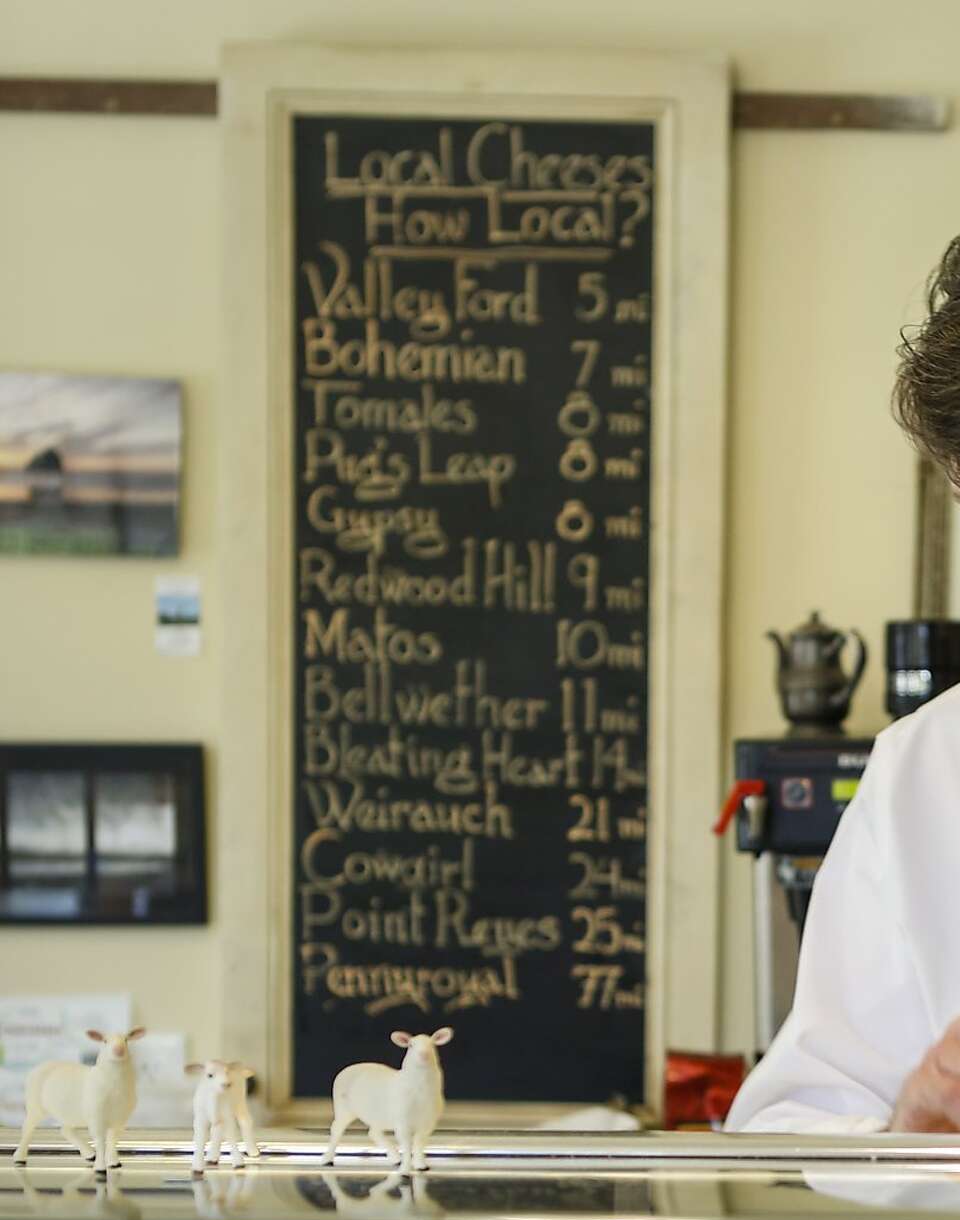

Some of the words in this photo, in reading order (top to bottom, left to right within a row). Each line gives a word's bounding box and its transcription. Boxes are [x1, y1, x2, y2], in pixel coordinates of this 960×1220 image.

[325, 127, 452, 194] Local
[365, 190, 471, 243] How
[488, 186, 649, 247] Local?
[302, 241, 450, 341] Valley
[455, 257, 542, 325] Ford
[575, 271, 607, 322] 5
[613, 294, 649, 324] mi
[303, 318, 527, 384] Bohemian
[570, 339, 601, 387] 7
[611, 353, 647, 387] mi
[303, 379, 477, 434] Tomales
[607, 398, 646, 435] mi
[418, 430, 516, 508] Leap
[559, 438, 598, 483] 8
[604, 447, 643, 480] mi
[307, 485, 448, 559] Gypsy
[605, 506, 642, 539] mi
[302, 537, 476, 605] Redwood
[484, 539, 556, 613] Hill
[567, 552, 599, 611] 9
[604, 577, 644, 610] mi
[305, 606, 442, 665] Matos
[305, 723, 478, 795] Bleating
[481, 722, 580, 789] Heart
[304, 777, 514, 839] Weirauch
[566, 793, 610, 842] 21
[302, 827, 475, 890] Cowgirl
[568, 851, 622, 898] 24
[301, 884, 425, 948] Point
[436, 885, 561, 956] Reyes
[570, 906, 621, 955] 25
[300, 941, 521, 1016] Pennyroyal
[570, 963, 622, 1009] 77
